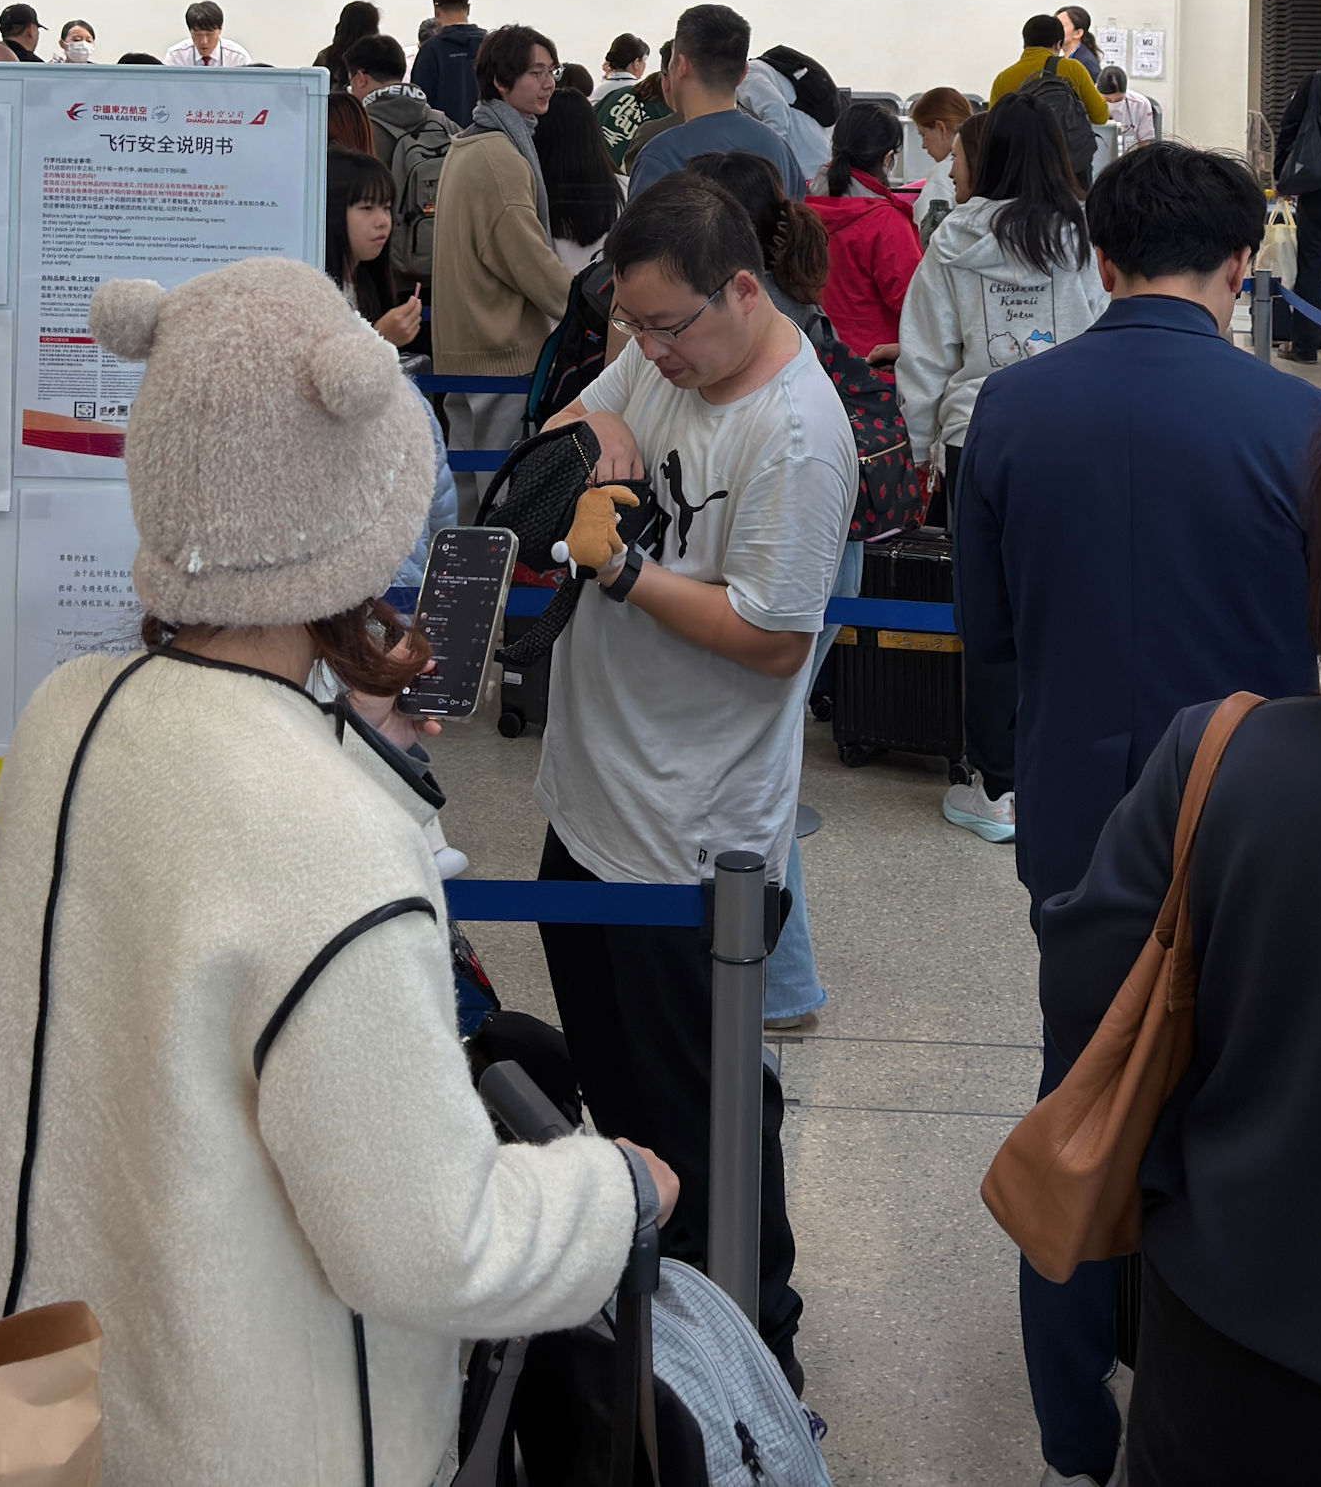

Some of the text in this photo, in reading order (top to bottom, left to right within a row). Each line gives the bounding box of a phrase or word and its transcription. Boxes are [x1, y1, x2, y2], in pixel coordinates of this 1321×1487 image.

[93, 105, 147, 114] 中國東方航空
[100, 133, 233, 155] 飞行安全说明书
[1000, 297, 1038, 305] Kawaii
[1006, 309, 1034, 321] Yatsu
